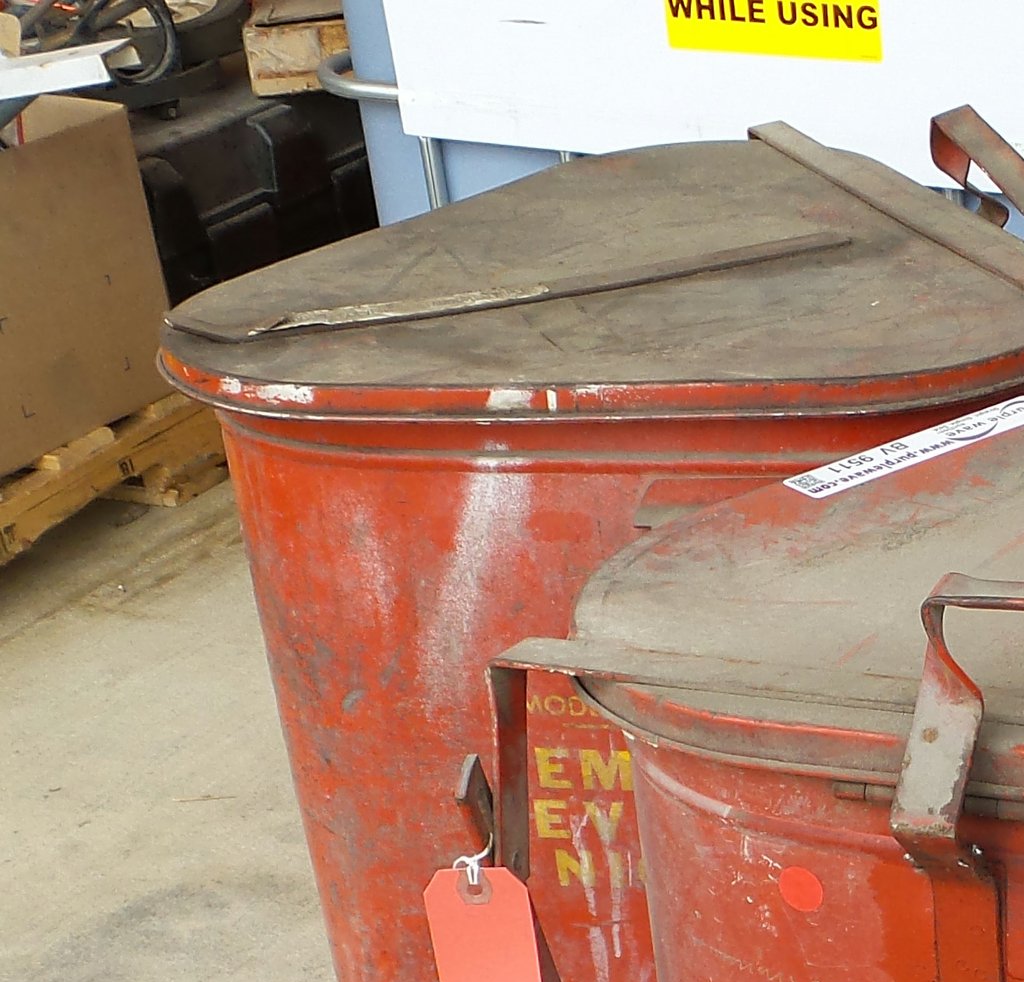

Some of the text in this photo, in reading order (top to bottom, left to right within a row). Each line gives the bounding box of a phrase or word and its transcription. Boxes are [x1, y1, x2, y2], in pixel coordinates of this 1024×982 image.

[668, 0, 879, 30] WHILE USING
[946, 421, 987, 437] wave
[808, 440, 955, 493] www.purplewave.com
[828, 442, 909, 474] BV 9511
